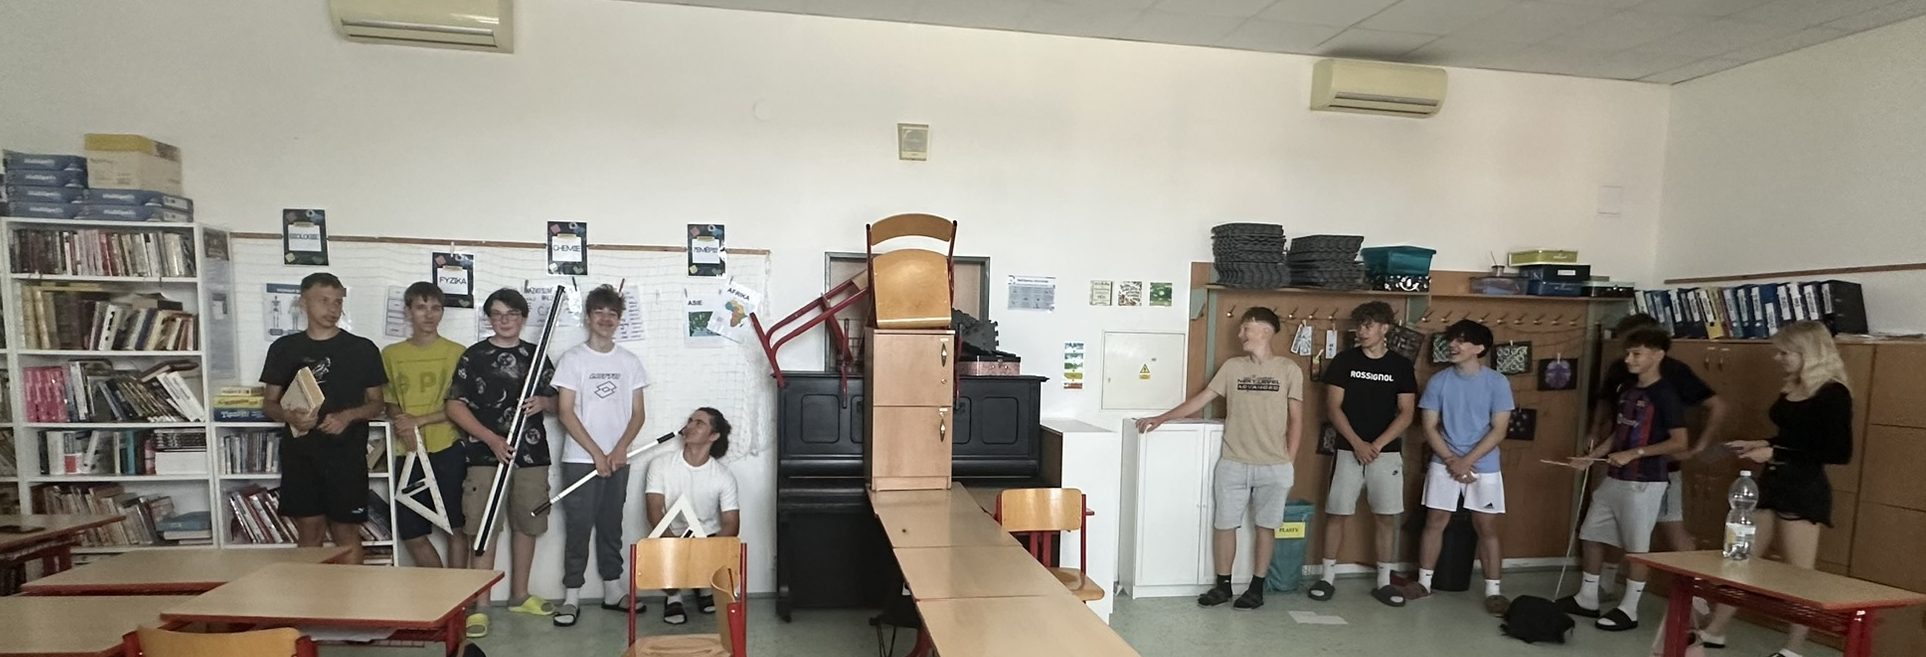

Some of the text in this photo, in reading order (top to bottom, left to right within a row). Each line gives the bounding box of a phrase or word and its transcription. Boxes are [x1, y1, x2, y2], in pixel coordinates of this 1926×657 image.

[552, 244, 581, 252] CHEMIE
[439, 276, 467, 285] FYZIKA
[727, 287, 750, 301] AFRIKA
[1350, 370, 1394, 382] ROSSIGNOL
